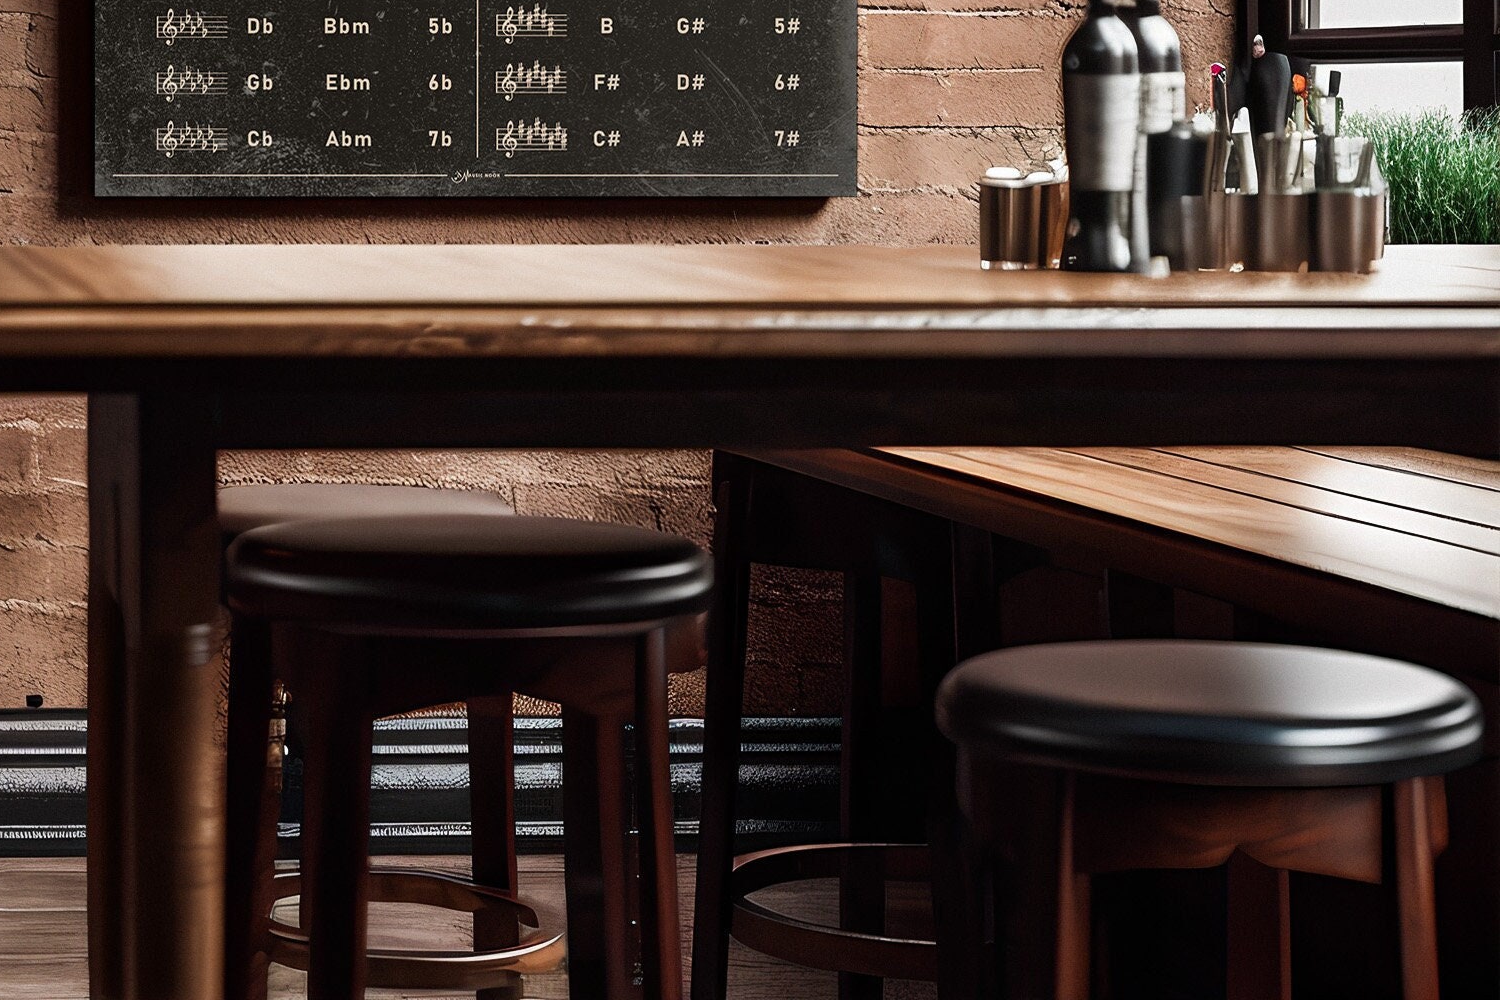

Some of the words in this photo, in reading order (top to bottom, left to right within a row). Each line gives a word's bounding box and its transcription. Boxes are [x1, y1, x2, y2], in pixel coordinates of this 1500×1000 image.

[248, 18, 272, 33] Db
[325, 18, 369, 33] Bbm
[429, 18, 452, 33] 5b
[601, 18, 613, 33] B
[677, 18, 704, 33] G#
[775, 18, 800, 34] 5#
[246, 74, 272, 90] Gb
[327, 74, 370, 90] Ebm
[429, 74, 451, 90] 6b
[595, 74, 620, 90] F#
[678, 74, 704, 90] D#
[775, 74, 799, 90] 6#
[248, 131, 272, 146] Cb
[326, 131, 371, 146] Abm
[429, 131, 451, 146] 7b
[594, 131, 620, 146] C#
[677, 131, 704, 146] A#
[775, 131, 799, 146] 7#
